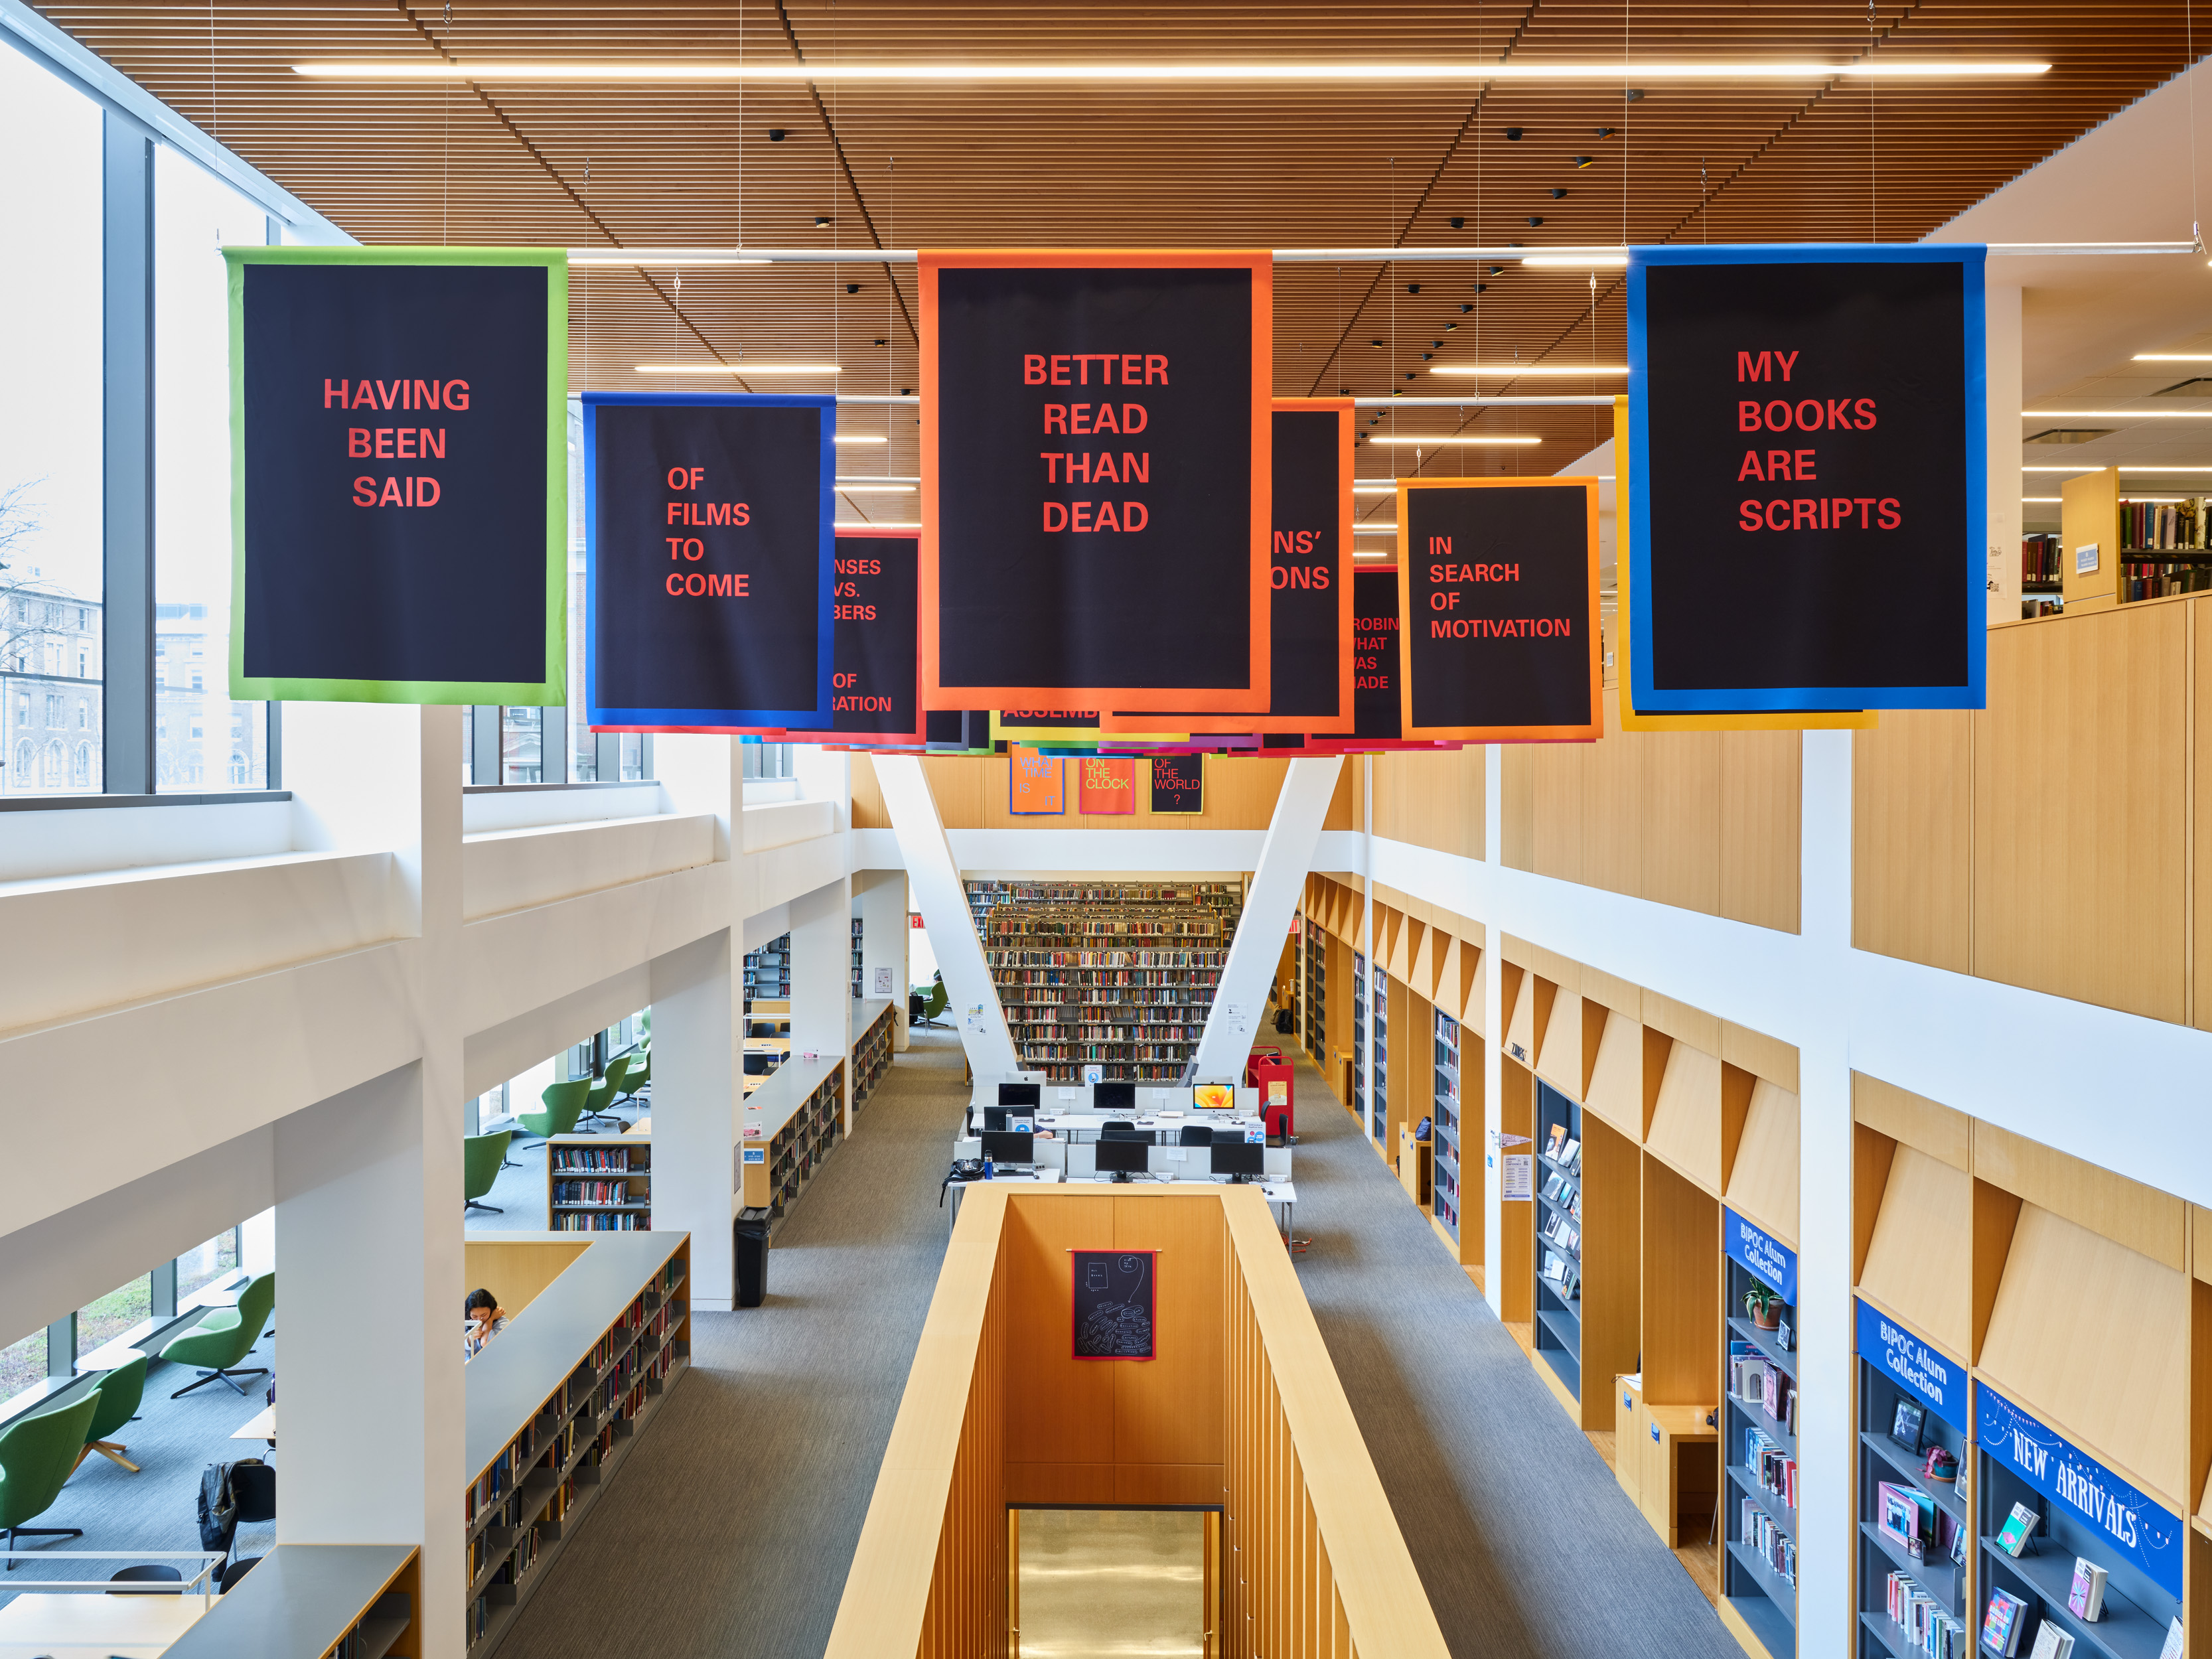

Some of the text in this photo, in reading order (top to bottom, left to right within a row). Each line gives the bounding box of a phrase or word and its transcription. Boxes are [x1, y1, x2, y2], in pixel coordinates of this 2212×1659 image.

[1025, 354, 1168, 385] BETTER
[1738, 351, 1799, 382] MY
[325, 379, 469, 410] HAVING
[1045, 403, 1147, 434] READ
[1739, 398, 1876, 431] BOOKS
[349, 428, 445, 458] BEEN
[1041, 453, 1149, 483] THAN
[1738, 449, 1816, 481] ARE
[668, 467, 704, 490] OF
[353, 476, 440, 506] SAID
[668, 502, 749, 526] FILMS
[1044, 502, 1148, 532] DEAD
[1739, 498, 1901, 531] SCRIPTS
[666, 538, 703, 561] TO
[1430, 537, 1451, 554] IN
[1270, 566, 1329, 589] ONS
[1430, 563, 1519, 583] SEARCH
[666, 573, 749, 596] COME
[834, 582, 860, 597] VS.
[1431, 593, 1460, 611] OF
[1432, 618, 1570, 638] MOTIVATION
[1354, 638, 1387, 650] HAT
[1354, 657, 1377, 670] AS
[833, 673, 857, 688] OF
[1354, 676, 1388, 689] ADE
[833, 696, 891, 711] ATION
[1020, 757, 1055, 767] WHAT
[1086, 758, 1104, 768] ON
[1154, 758, 1171, 768] OF
[1023, 768, 1052, 778] TIME
[1086, 768, 1110, 778] THE
[1154, 768, 1179, 779] THE
[1019, 783, 1030, 793] IS
[1086, 778, 1130, 789] CLOCK
[1154, 780, 1200, 790] WORLD
[1045, 796, 1056, 806] IT
[1174, 794, 1181, 805] ?
[913, 916, 925, 928] EXI
[1741, 1222, 1786, 1268] BIPOC Alum
[1745, 1244, 1783, 1285] Collection
[1880, 1321, 1947, 1386] BIPOC Alum
[1886, 1348, 1943, 1406] Collection
[2014, 1428, 2136, 1548] NEW ARRIVALS
[1989, 1605, 2010, 1624] BODIES ON
[1997, 1620, 2006, 1630] LINE
